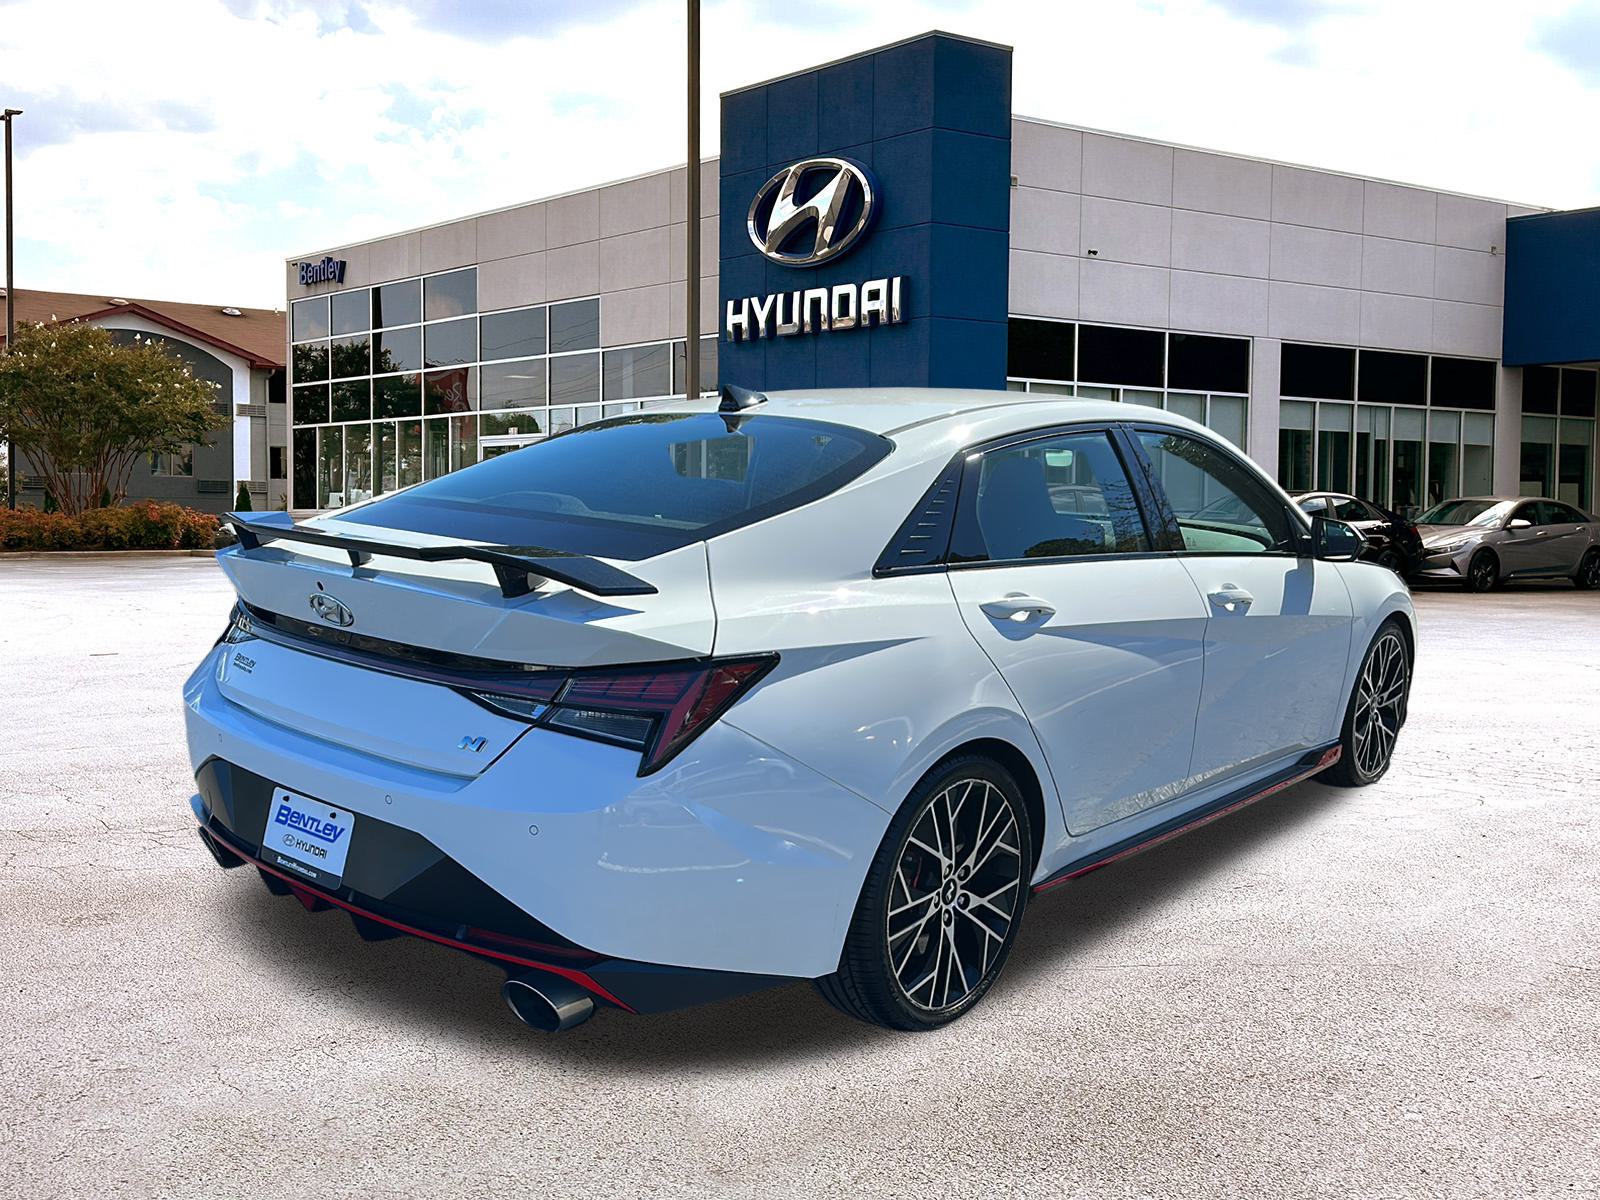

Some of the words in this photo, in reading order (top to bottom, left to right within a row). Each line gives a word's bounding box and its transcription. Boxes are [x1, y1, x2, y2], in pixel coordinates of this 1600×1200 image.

[299, 257, 346, 286] Bentley
[726, 276, 902, 342] HYUNDAI
[295, 838, 328, 859] HYUNDAI
